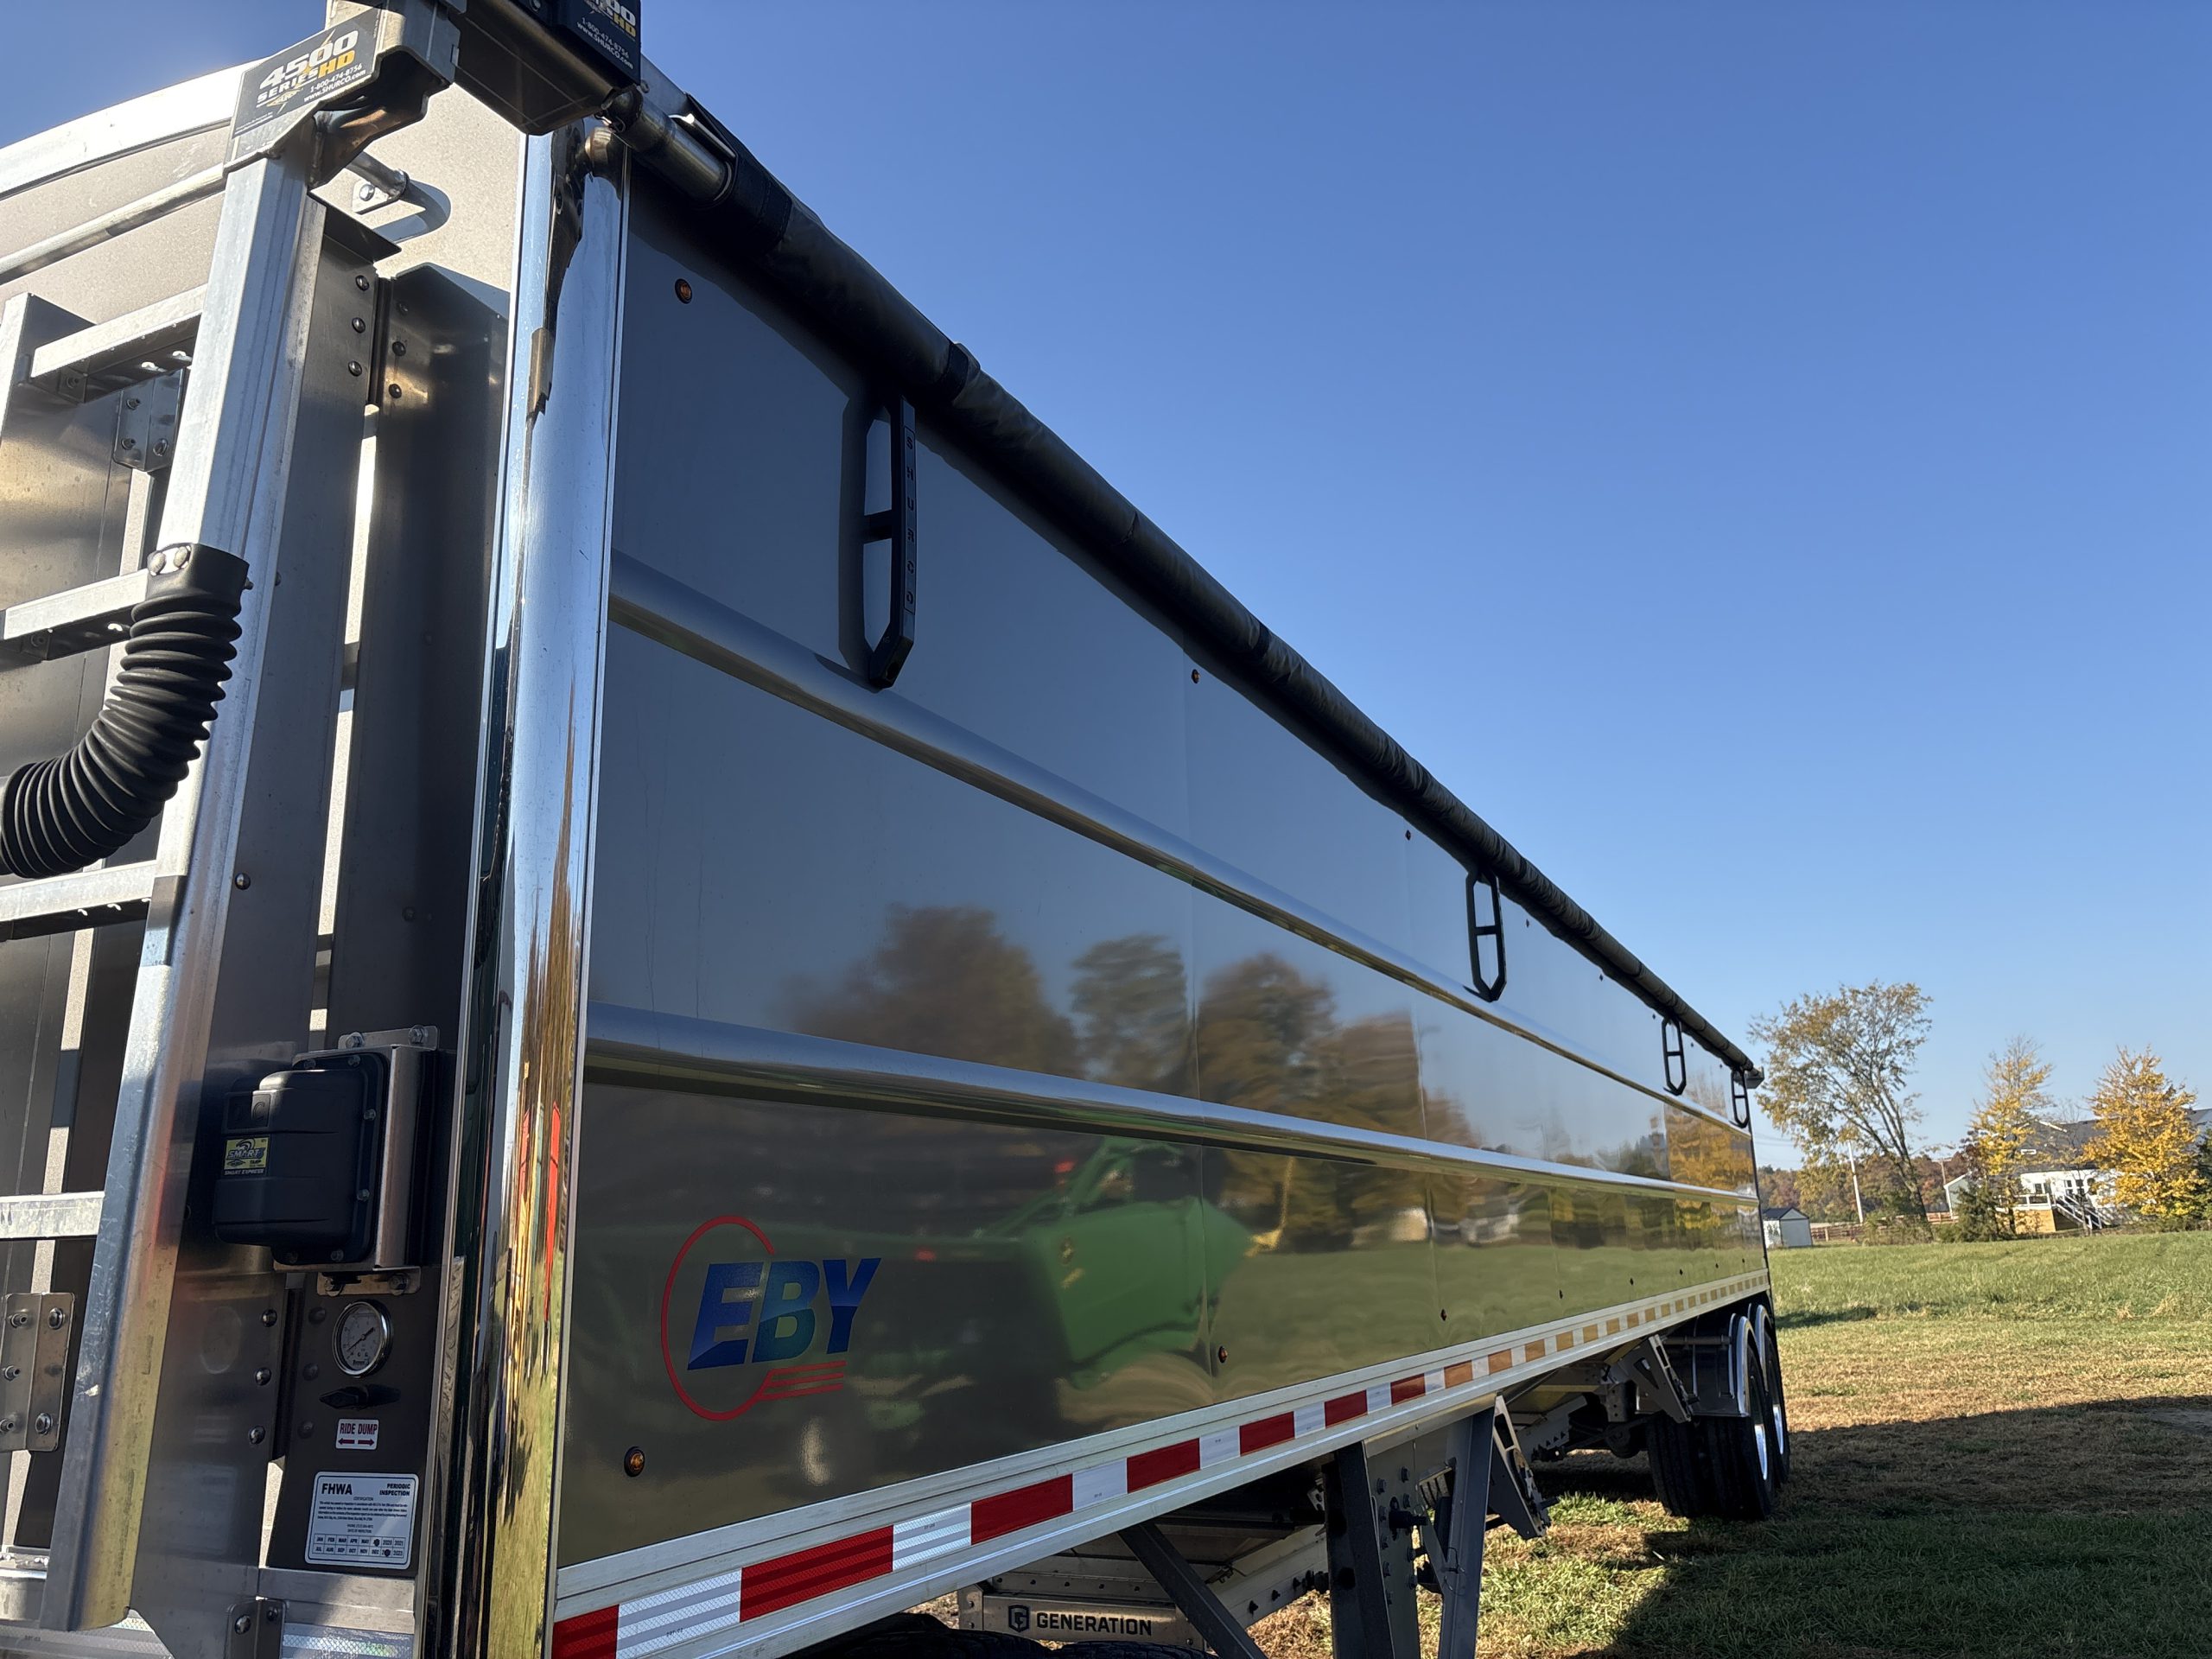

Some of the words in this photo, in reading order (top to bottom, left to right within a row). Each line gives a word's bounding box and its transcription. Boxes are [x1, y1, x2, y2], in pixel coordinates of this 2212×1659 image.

[582, 17, 630, 59] 1-800-474-8756
[613, 12, 637, 38] HD
[259, 30, 359, 90] 4500
[576, 22, 633, 70] www.SHURCO.com
[257, 66, 320, 103] SERIES
[318, 50, 355, 79] HD
[303, 69, 366, 103] www.SHURCO.com
[310, 63, 363, 92] 1-800-474-8756
[687, 1257, 881, 1370] EBY
[340, 1422, 356, 1434] RIDE
[358, 1423, 378, 1435] DUMP
[321, 1483, 353, 1495] FHWA
[1036, 1611, 1152, 1637] GENERATION
